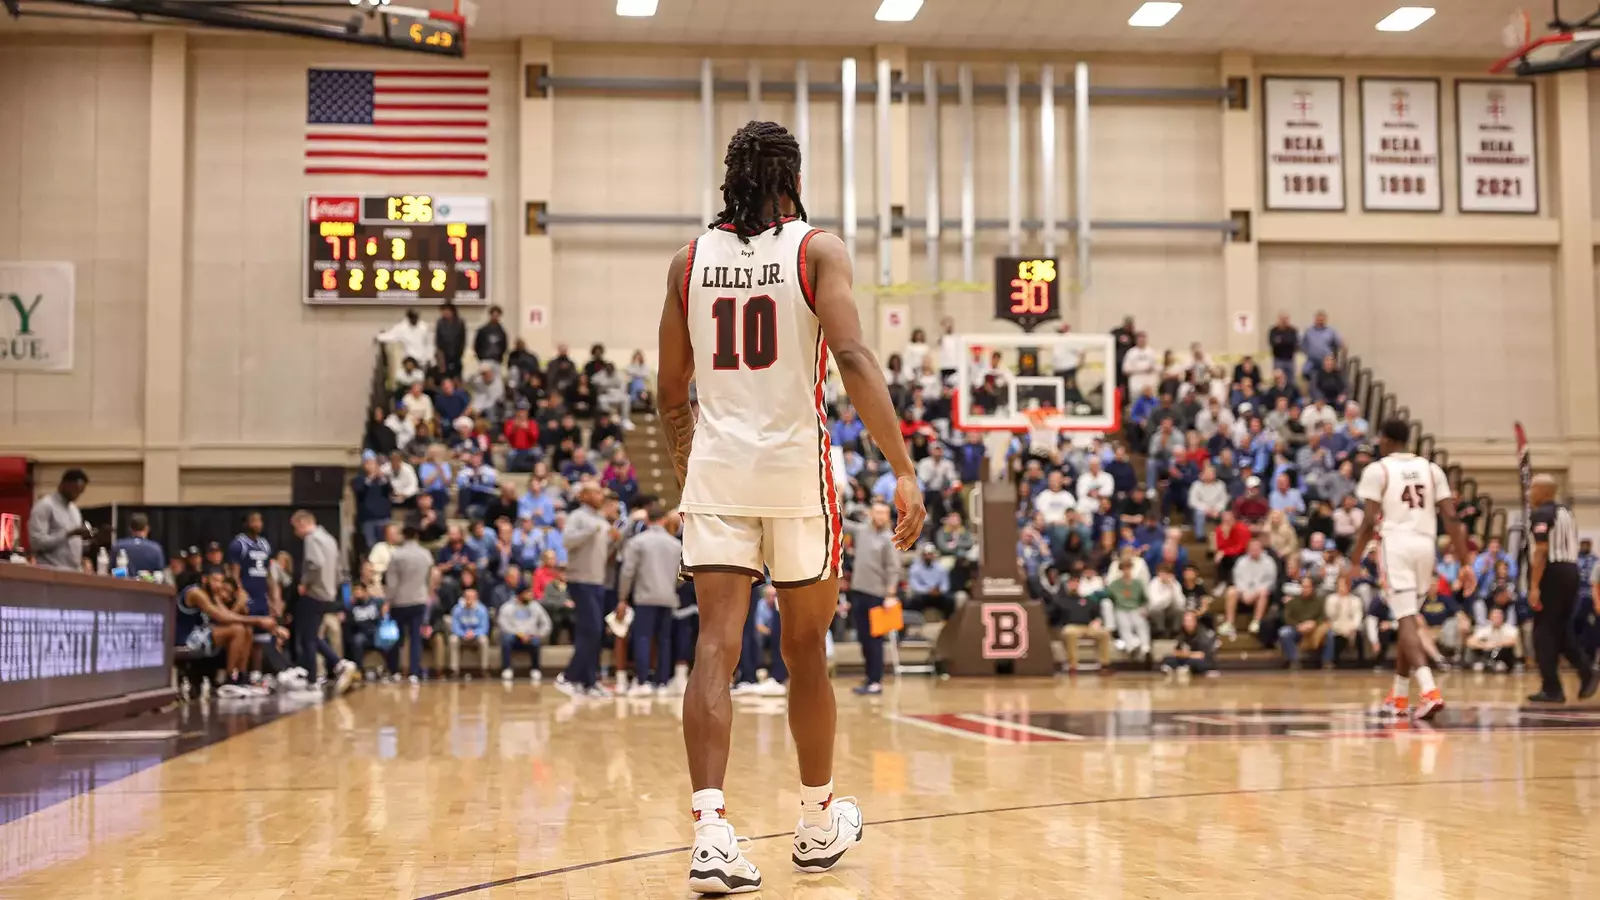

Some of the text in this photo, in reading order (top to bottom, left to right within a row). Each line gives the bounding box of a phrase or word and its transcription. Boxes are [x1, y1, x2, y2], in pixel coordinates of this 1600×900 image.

[1476, 177, 1522, 196] 2021
[702, 263, 784, 288] LILLY JR.
[1010, 279, 1049, 314] 30
[712, 294, 778, 370] 10
[1401, 484, 1425, 509] 45
[981, 602, 1029, 659] B
